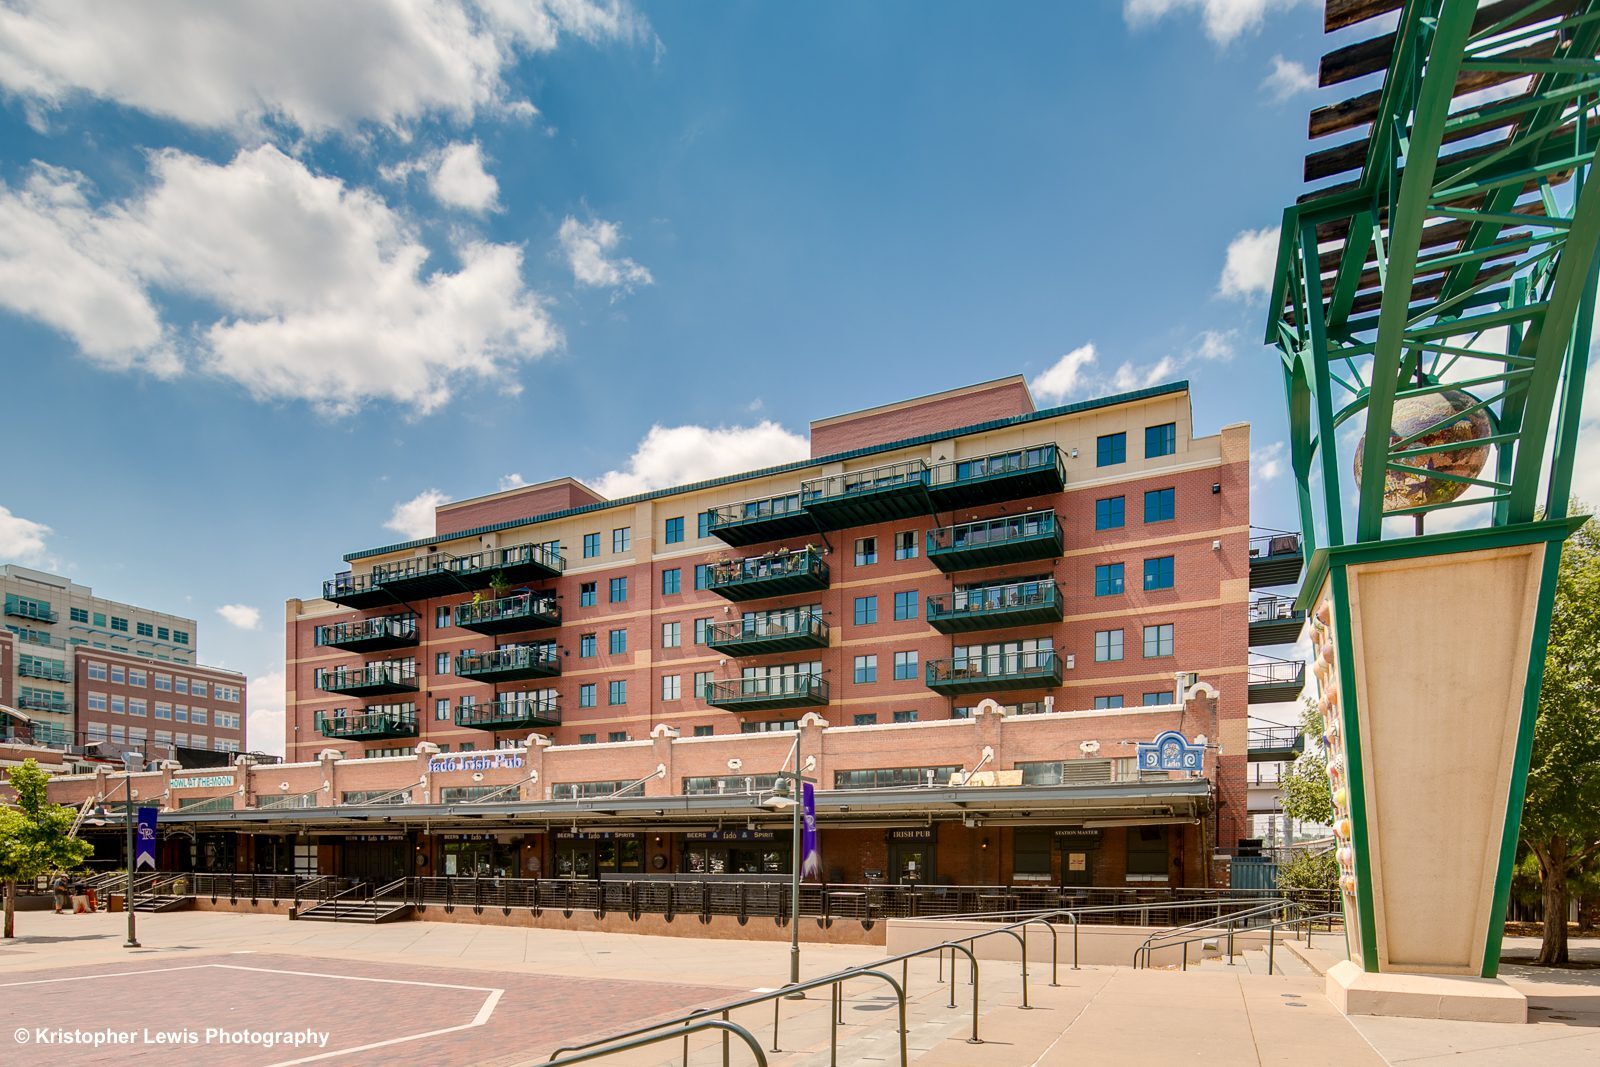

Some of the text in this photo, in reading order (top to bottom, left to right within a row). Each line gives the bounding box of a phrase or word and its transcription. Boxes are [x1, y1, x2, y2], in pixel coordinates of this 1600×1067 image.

[461, 755, 492, 771] Irish
[495, 753, 523, 769] Pub
[169, 776, 232, 788] HOWL AT THE MOON
